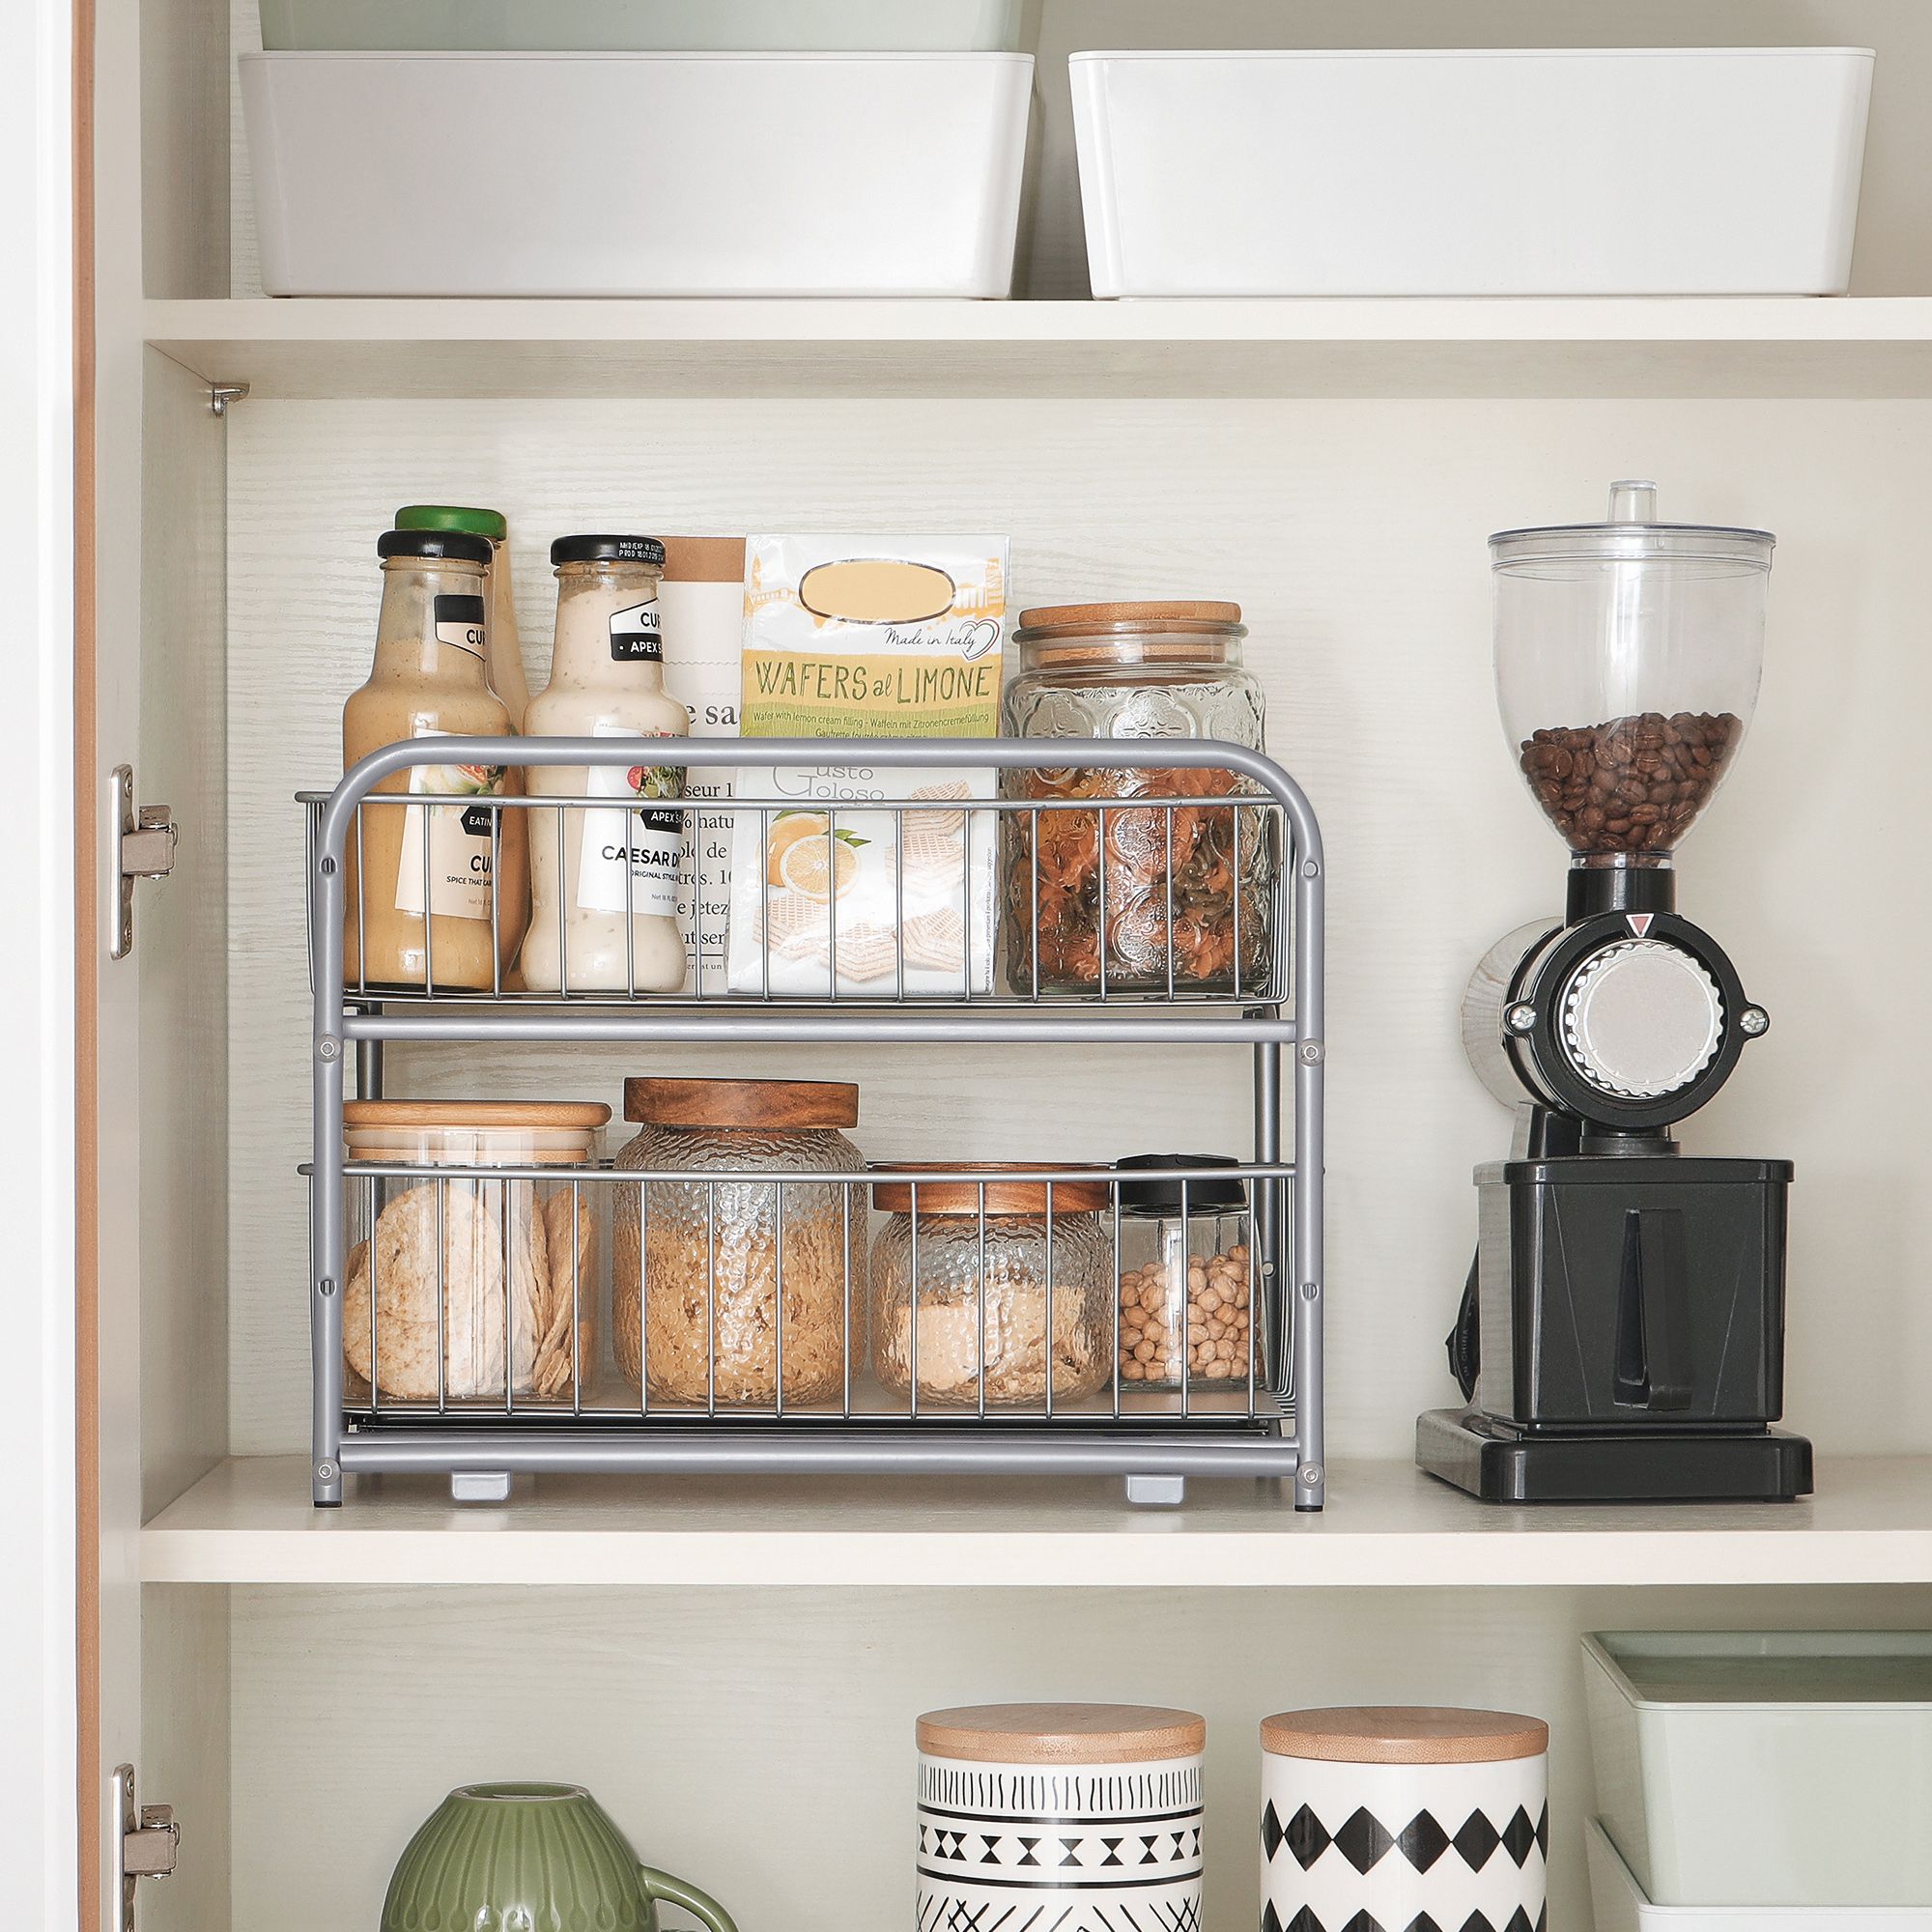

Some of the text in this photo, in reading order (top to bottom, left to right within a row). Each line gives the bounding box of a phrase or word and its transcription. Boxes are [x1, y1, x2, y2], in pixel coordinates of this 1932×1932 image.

[884, 627, 977, 653] Made in Italy
[755, 661, 993, 704] WAFERS al LIMONE
[705, 705, 741, 725] sa
[753, 712, 774, 722] Wafer
[776, 711, 792, 721] with
[793, 713, 817, 724] lemon
[818, 716, 842, 725] cream
[843, 717, 864, 728] filling
[870, 719, 897, 729] Waffeln
[913, 713, 989, 729] Zitronencremefüllung
[469, 815, 493, 827] EATIN
[602, 845, 681, 868] CAESAR D
[707, 841, 727, 859] de
[470, 855, 492, 873] CU
[446, 875, 467, 884] SPICE
[690, 899, 728, 921] jetez
